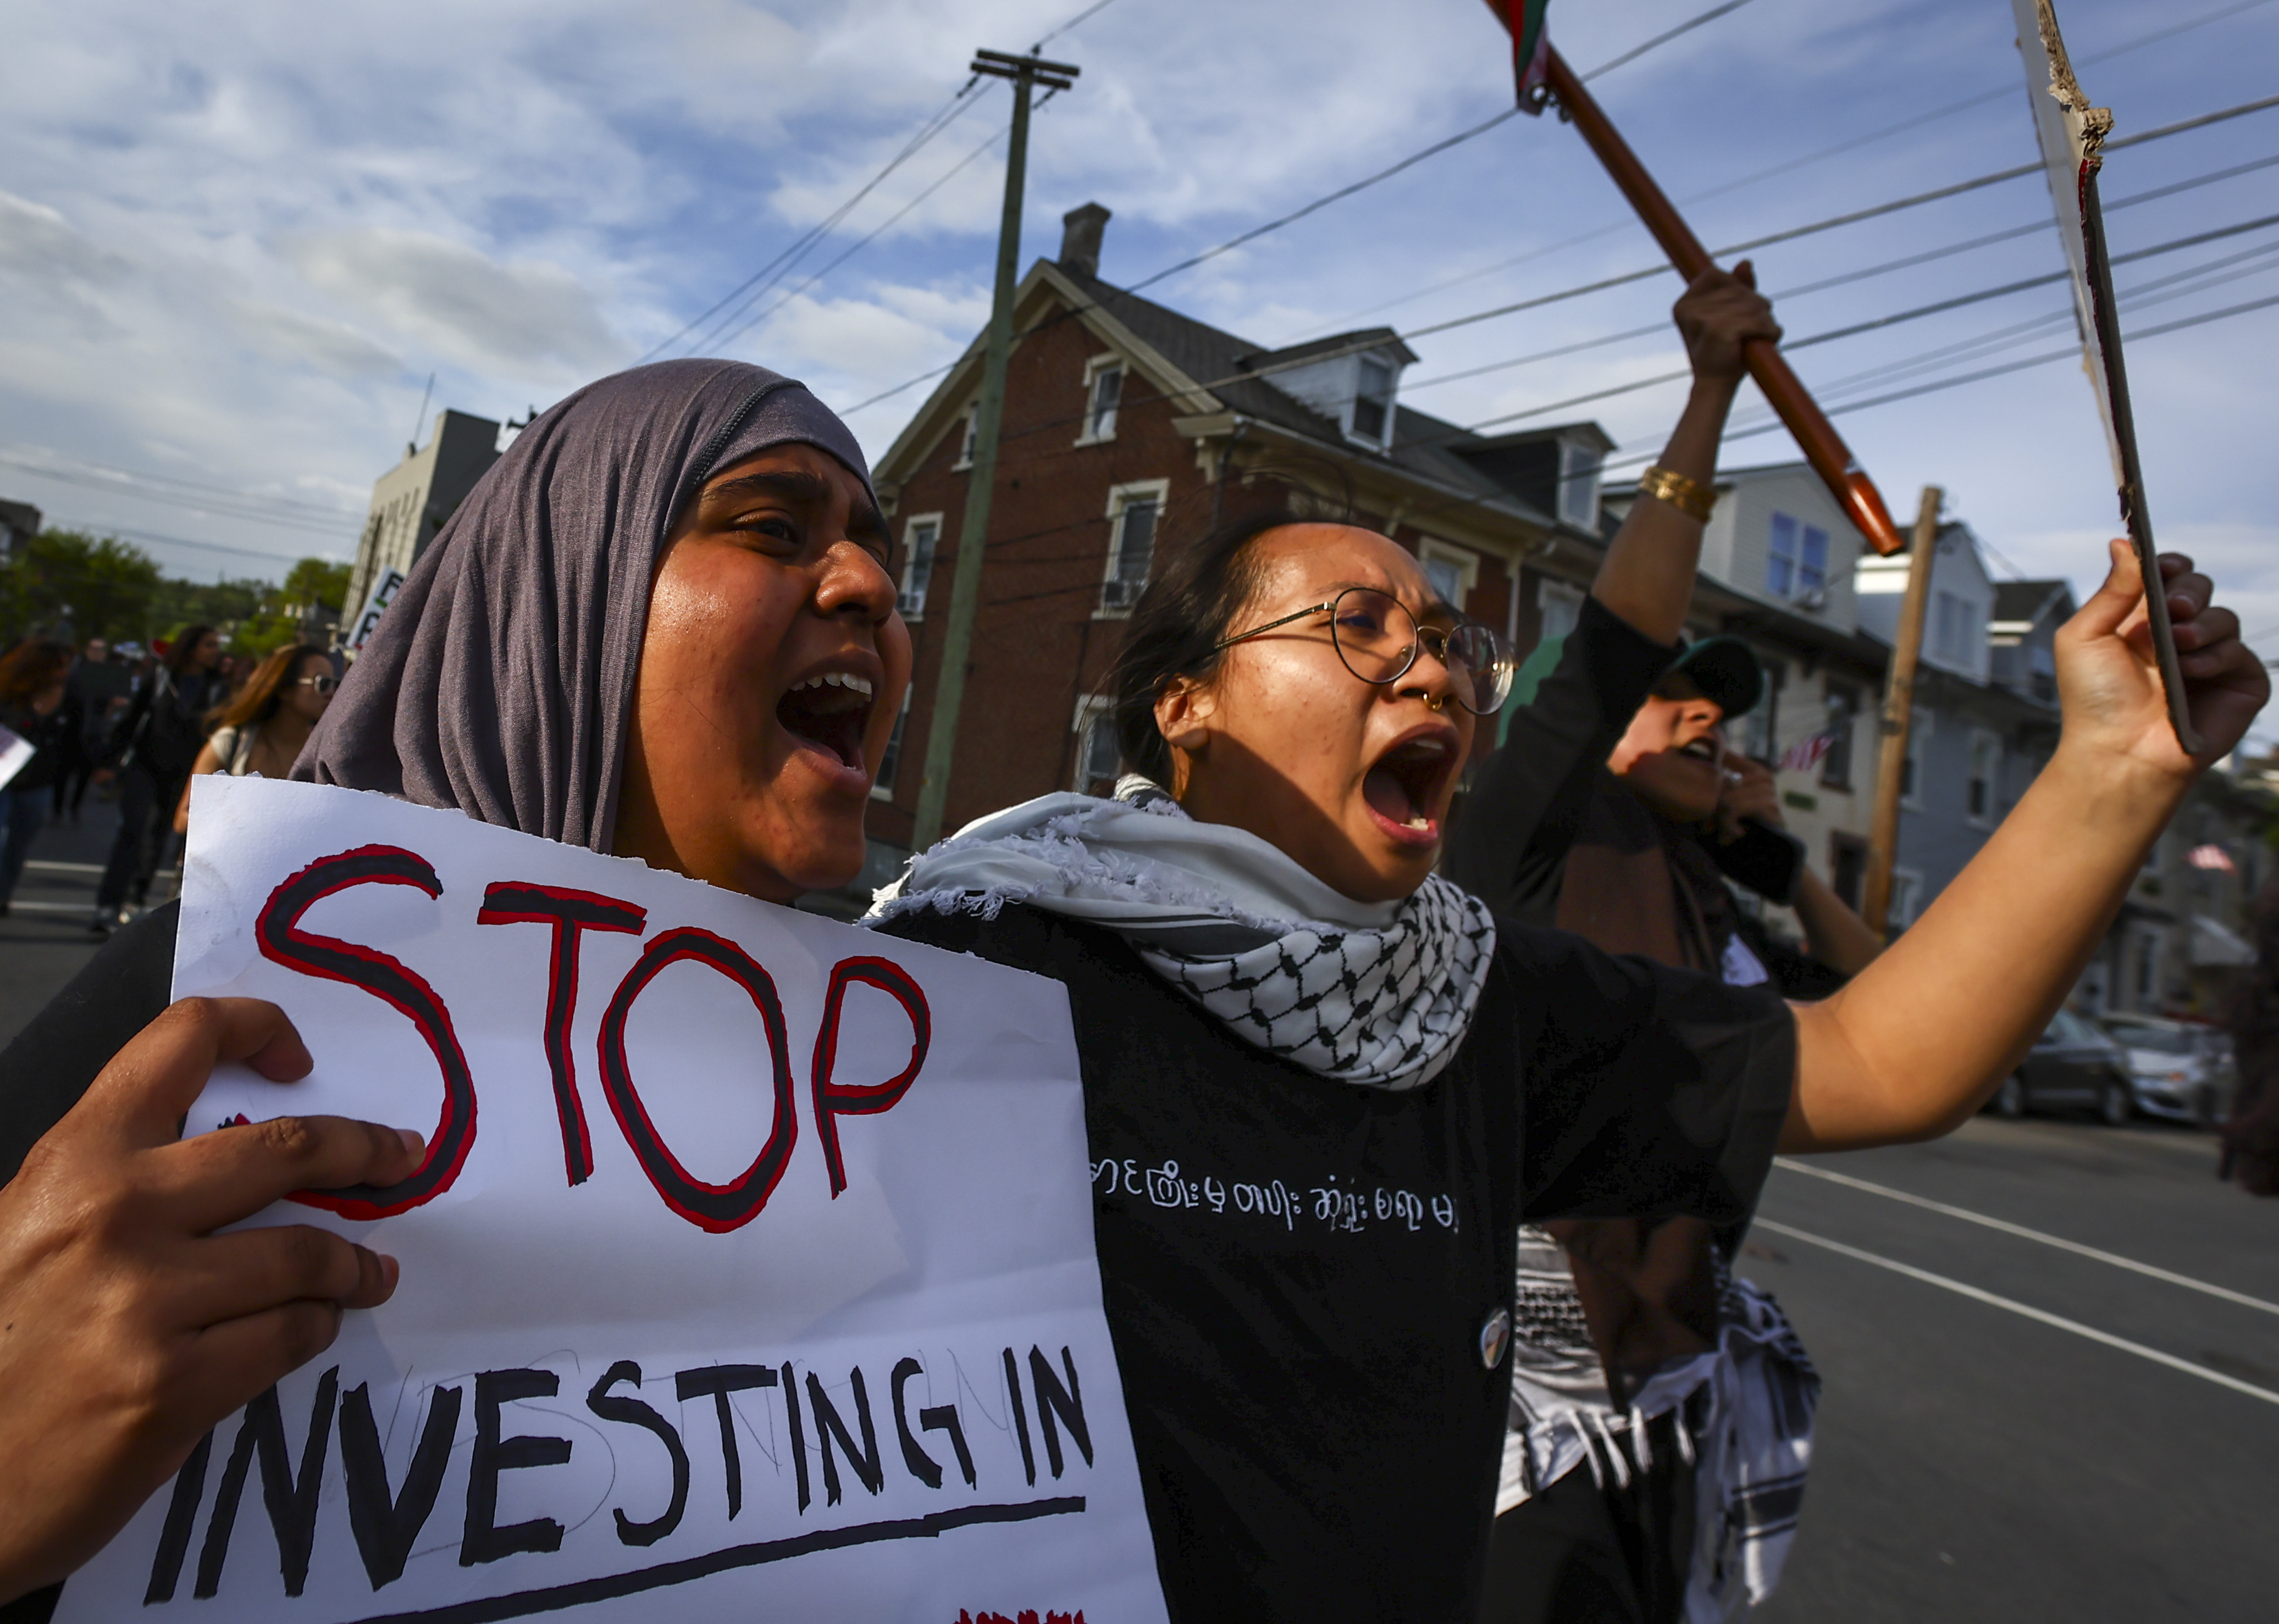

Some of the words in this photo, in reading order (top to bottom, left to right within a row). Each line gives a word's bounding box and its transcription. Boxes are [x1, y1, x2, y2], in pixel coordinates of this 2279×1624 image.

[218, 844, 931, 1234] STOP
[143, 1357, 976, 1606] INVESTING
[1002, 1344, 1093, 1487] IN
